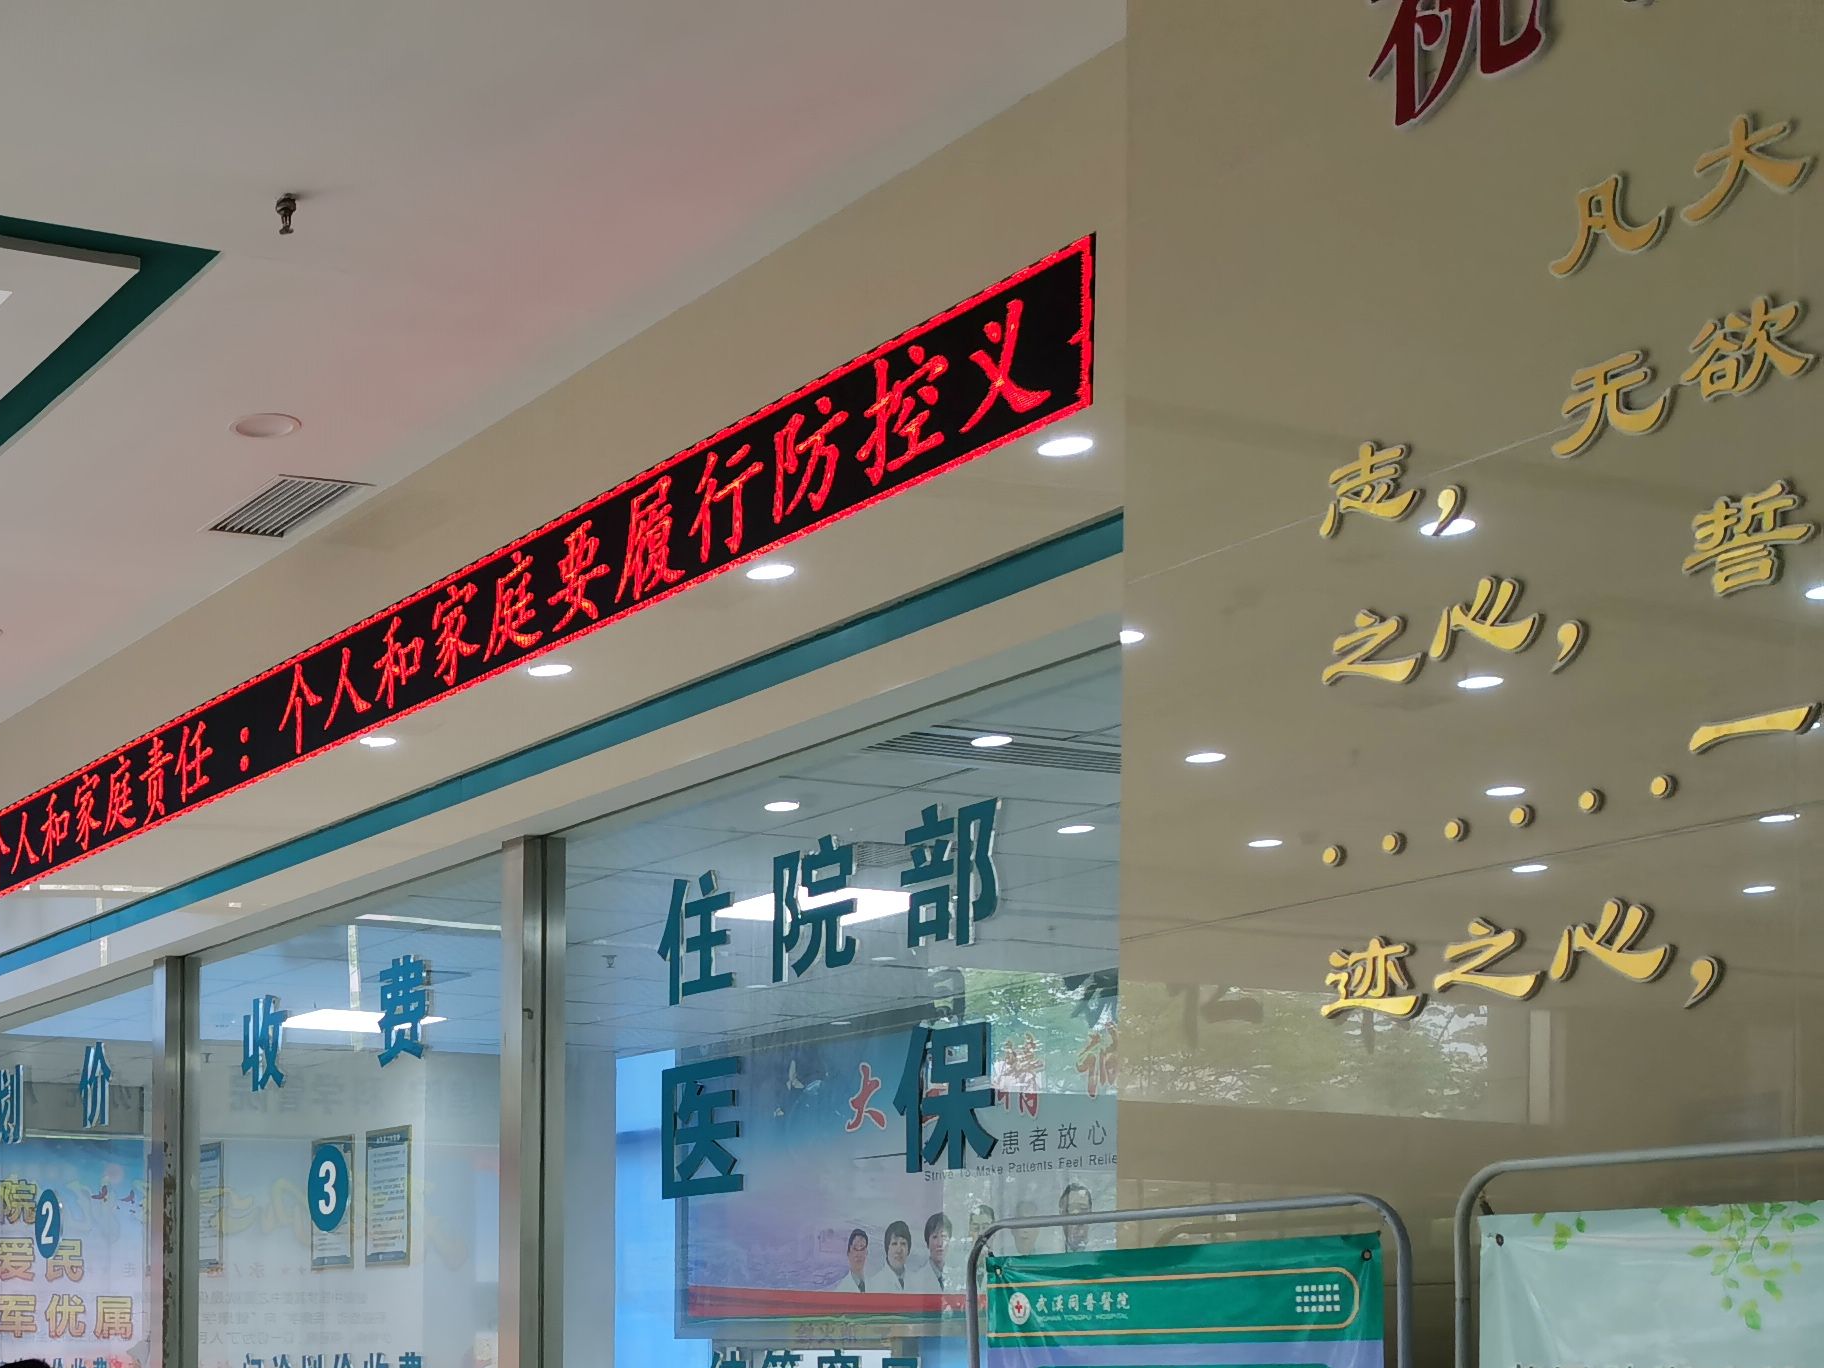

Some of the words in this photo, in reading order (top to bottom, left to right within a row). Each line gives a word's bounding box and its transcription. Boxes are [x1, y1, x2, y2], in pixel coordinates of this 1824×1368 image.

[658, 797, 1002, 1008] 住院部
[1321, 898, 1726, 1020] 迹之心，
[242, 954, 430, 1092] 收费
[661, 1022, 1000, 1201] 医保
[40, 1199, 55, 1246] 2
[317, 1160, 338, 1216] 3
